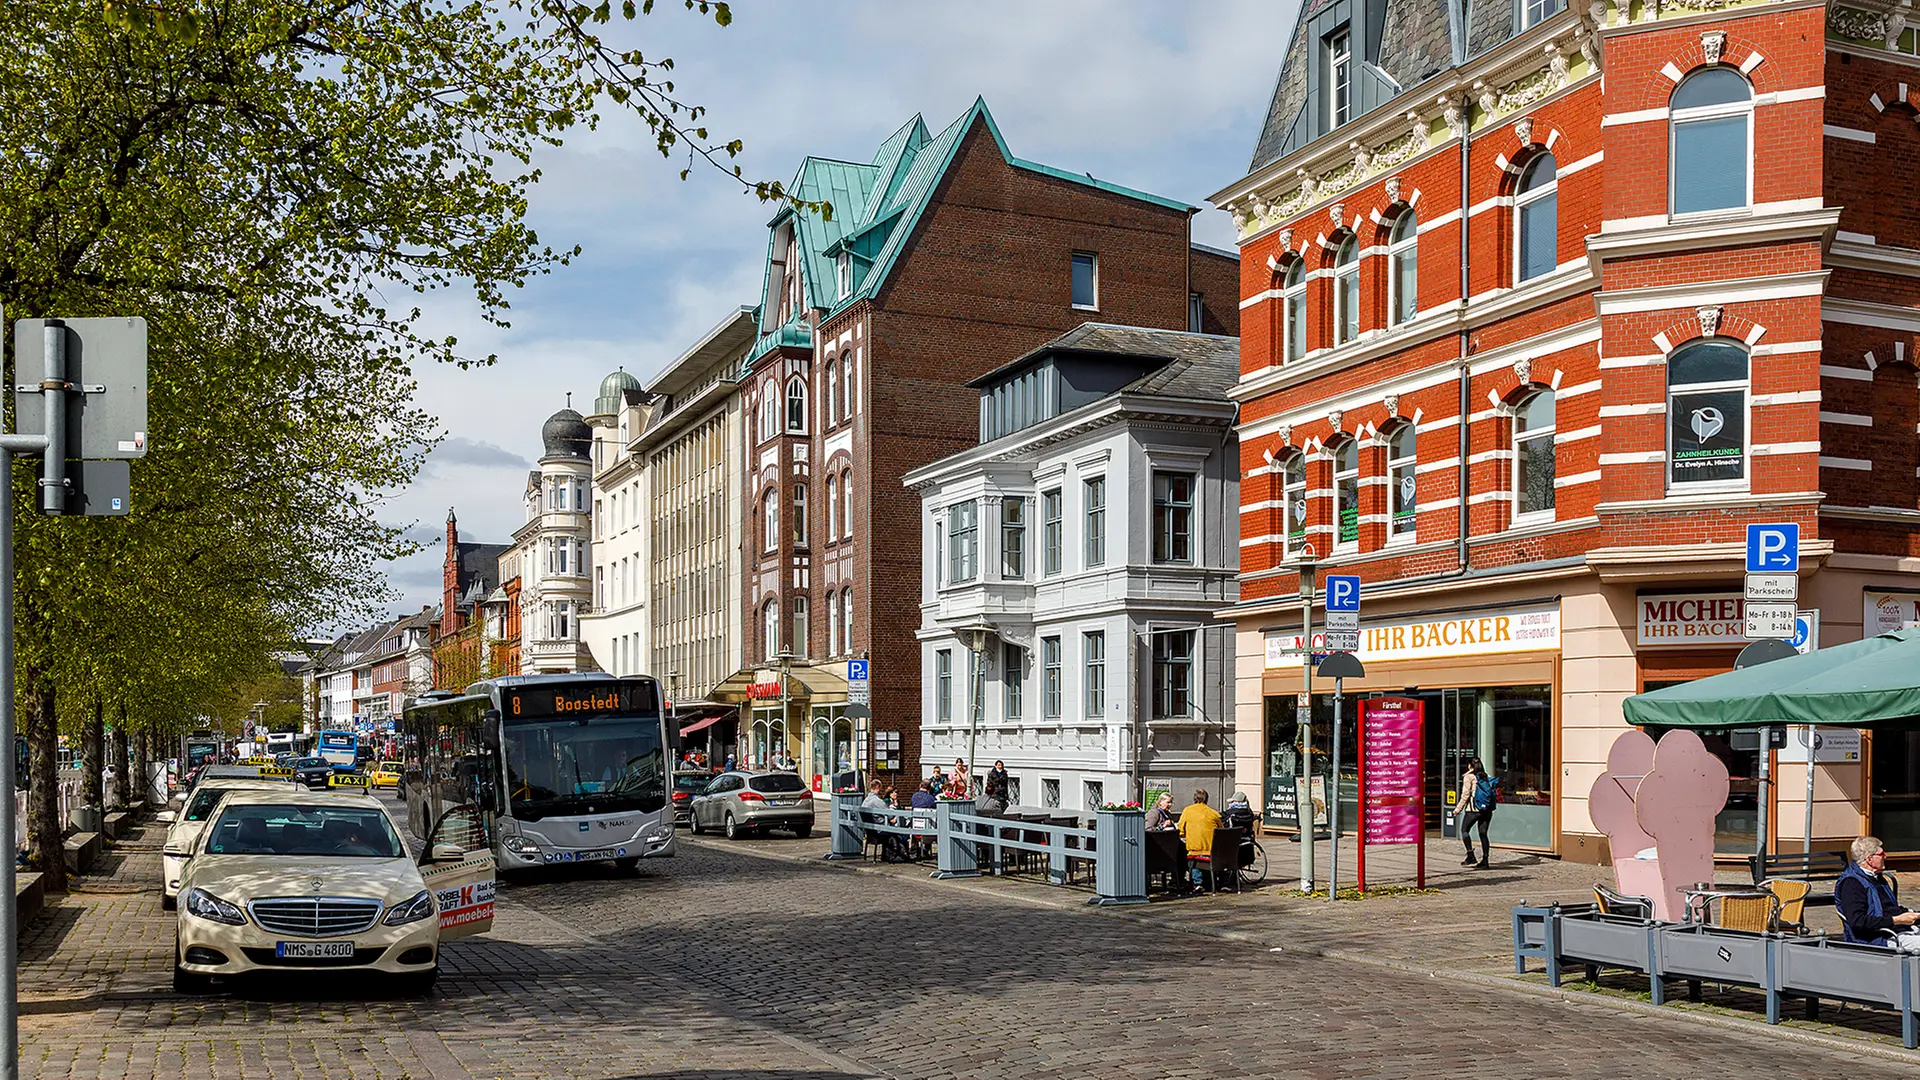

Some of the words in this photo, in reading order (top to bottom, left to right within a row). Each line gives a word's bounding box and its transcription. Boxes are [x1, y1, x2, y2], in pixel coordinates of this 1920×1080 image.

[1676, 448, 1740, 458] ZAHNHEILKUNDE
[1758, 530, 1786, 566] P
[1334, 580, 1352, 606] P
[1749, 587, 1793, 595] Parkschein
[1748, 611, 1769, 619] Mo-Fr
[1644, 625, 1679, 637] IHR
[1748, 623, 1756, 631] Sa
[1367, 626, 1406, 651] IHR
[1412, 616, 1511, 648] BÄCKER
[851, 663, 862, 678] P
[512, 696, 521, 715] 8
[556, 693, 619, 712] Boostedt
[339, 776, 364, 785] TAXI
[461, 885, 473, 906] K
[284, 944, 306, 956] NMS
[314, 944, 322, 956] G
[324, 944, 351, 956] 4800
